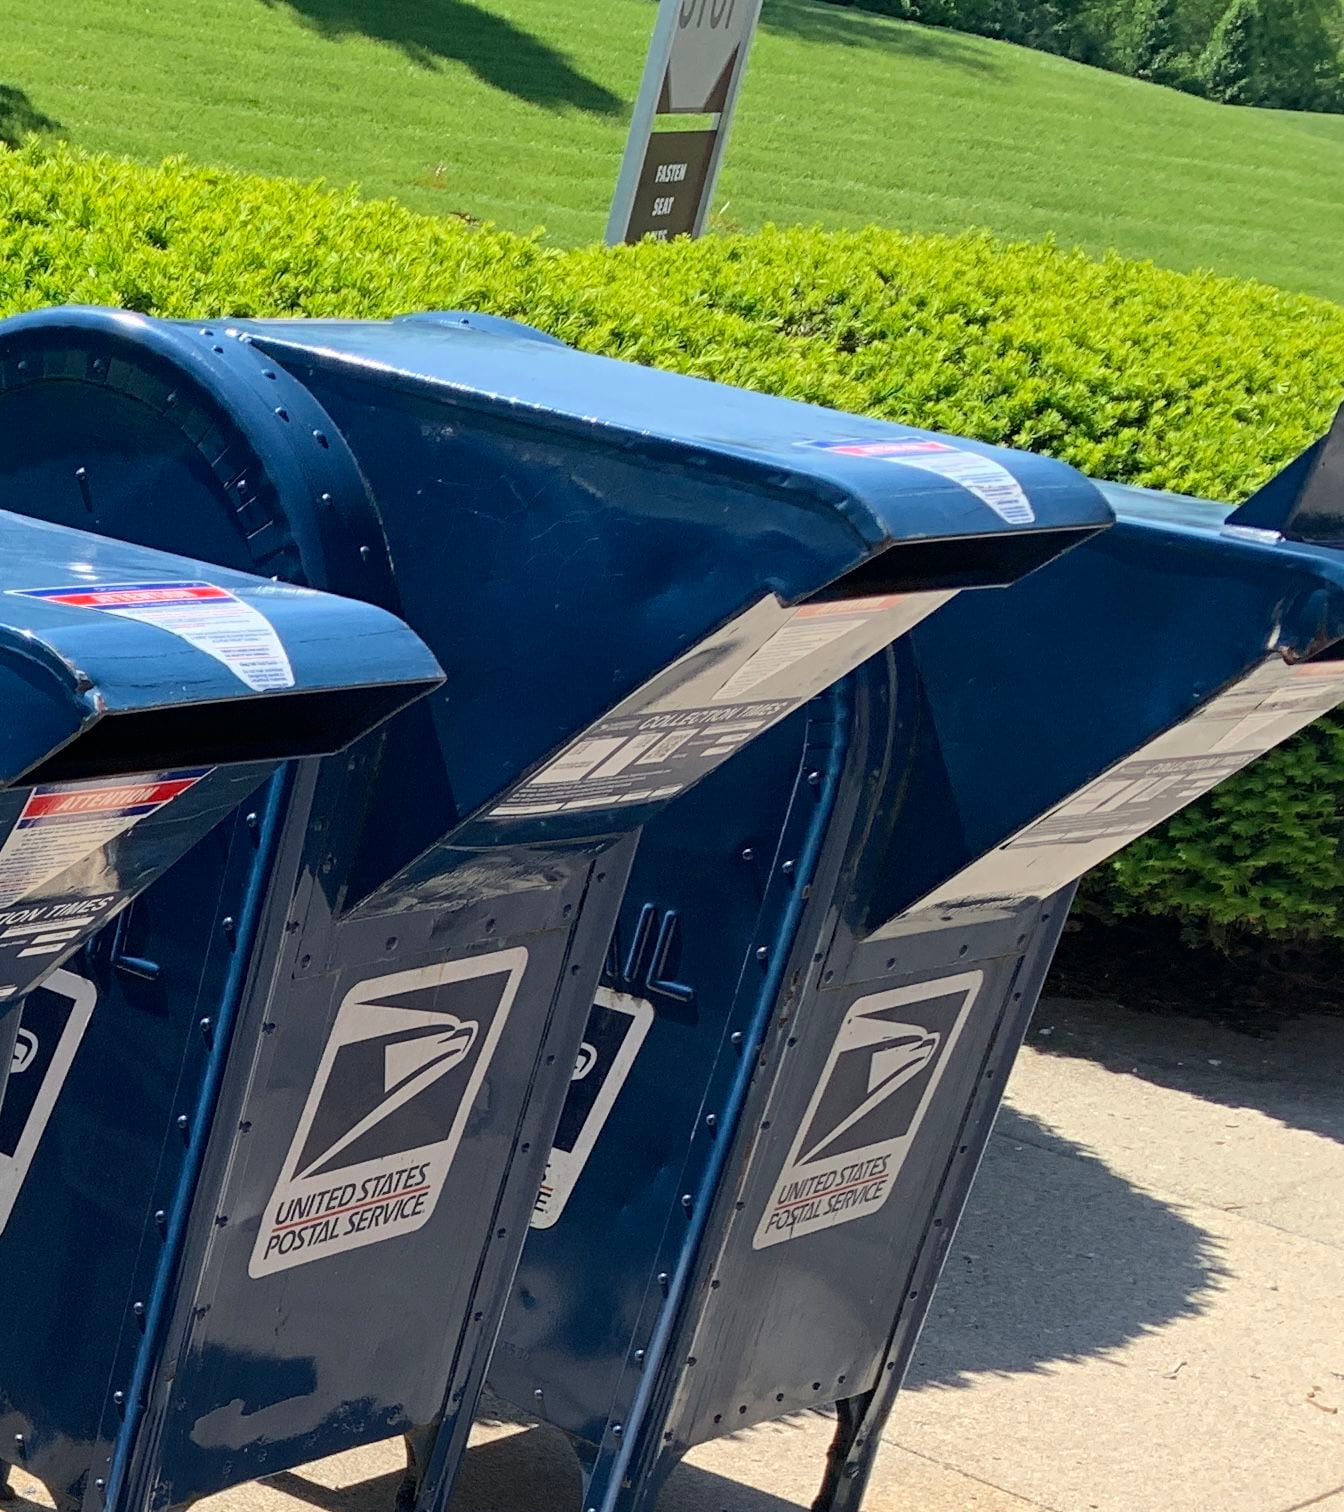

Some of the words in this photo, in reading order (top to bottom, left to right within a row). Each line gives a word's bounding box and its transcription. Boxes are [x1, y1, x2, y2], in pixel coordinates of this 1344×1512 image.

[655, 163, 688, 183] FASTEN
[652, 197, 674, 216] SEAT
[638, 706, 741, 731] COLLECTION
[739, 702, 788, 720] TIMES
[60, 786, 158, 811] ATTENTION
[44, 896, 114, 920] TIMES
[275, 1183, 357, 1226] UNITED
[360, 1163, 430, 1200] STATES
[777, 1170, 838, 1206] UNITED
[836, 1154, 891, 1187] STATES
[823, 1180, 887, 1216] SERVICE
[264, 1220, 340, 1260] POSTAL
[344, 1192, 429, 1235] SERVICE
